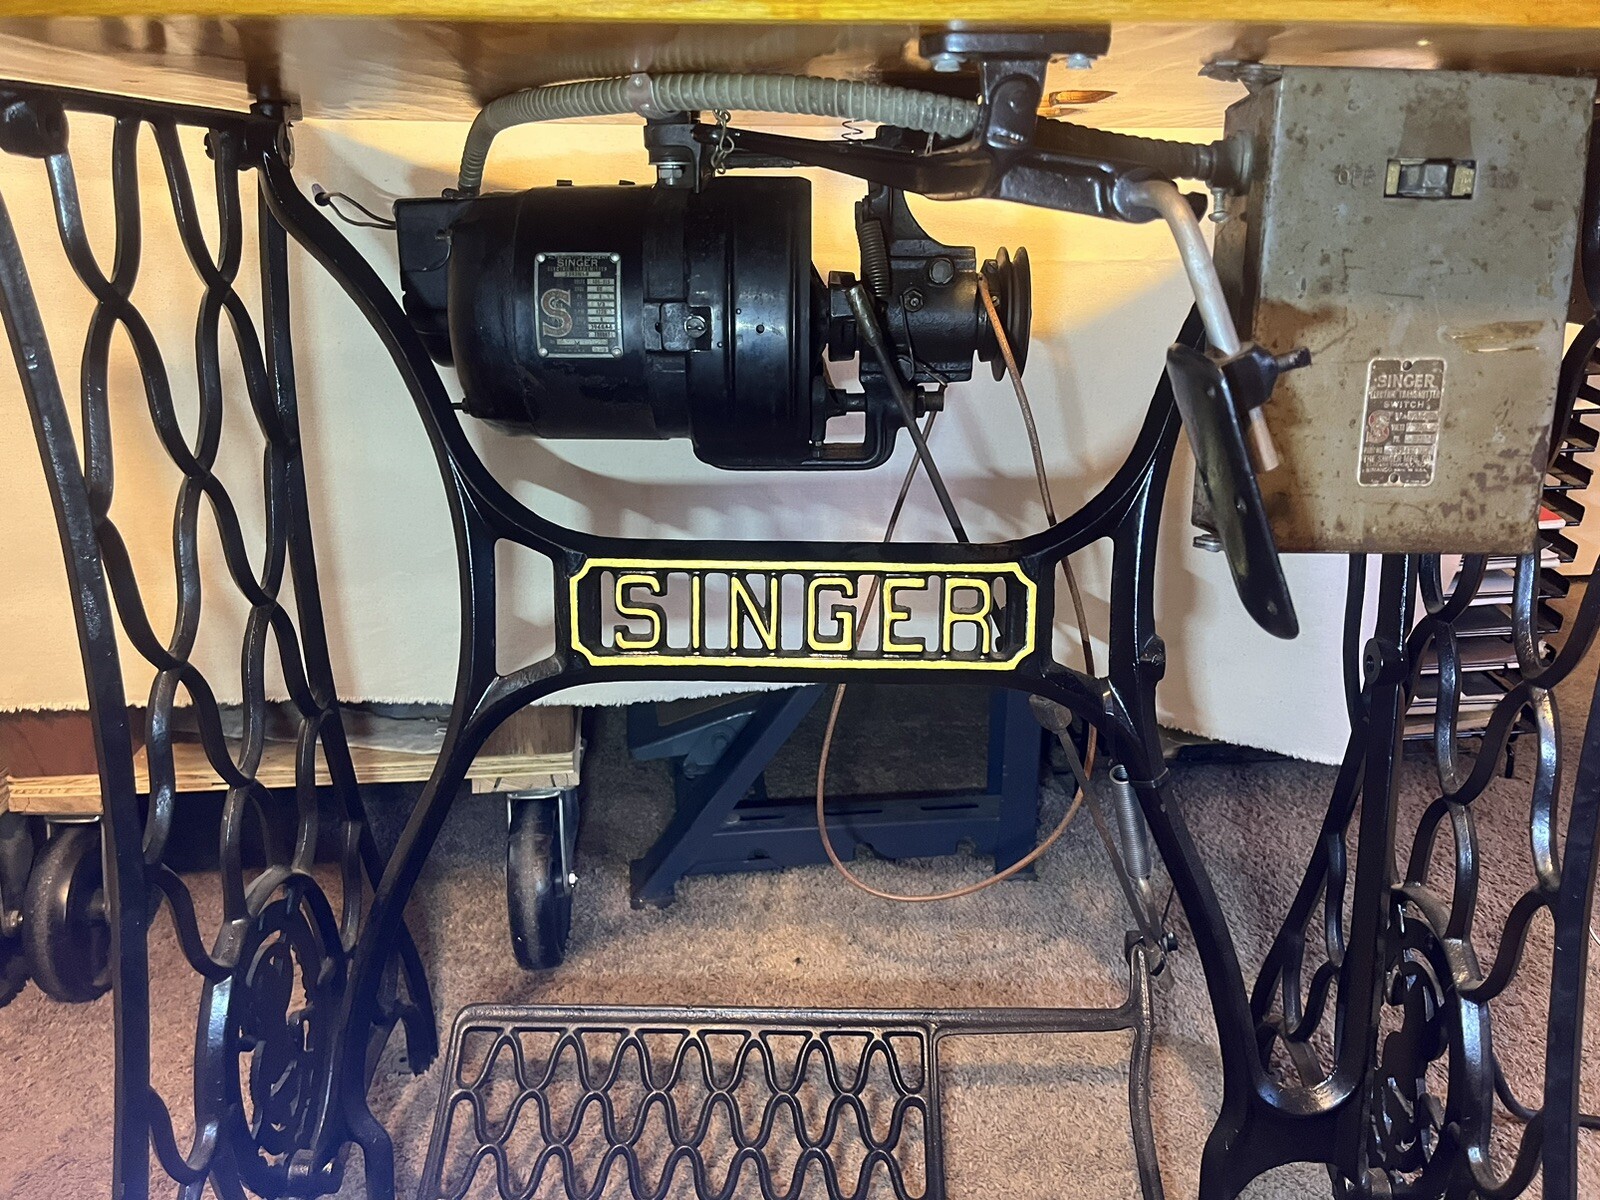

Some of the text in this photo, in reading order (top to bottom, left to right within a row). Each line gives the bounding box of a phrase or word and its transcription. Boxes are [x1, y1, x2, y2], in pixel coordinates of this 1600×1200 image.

[557, 259, 598, 267] SINGER
[541, 288, 572, 337] S
[1377, 373, 1435, 389] SINGER
[1383, 400, 1425, 409] SWITCH
[615, 575, 992, 654] SINGER
